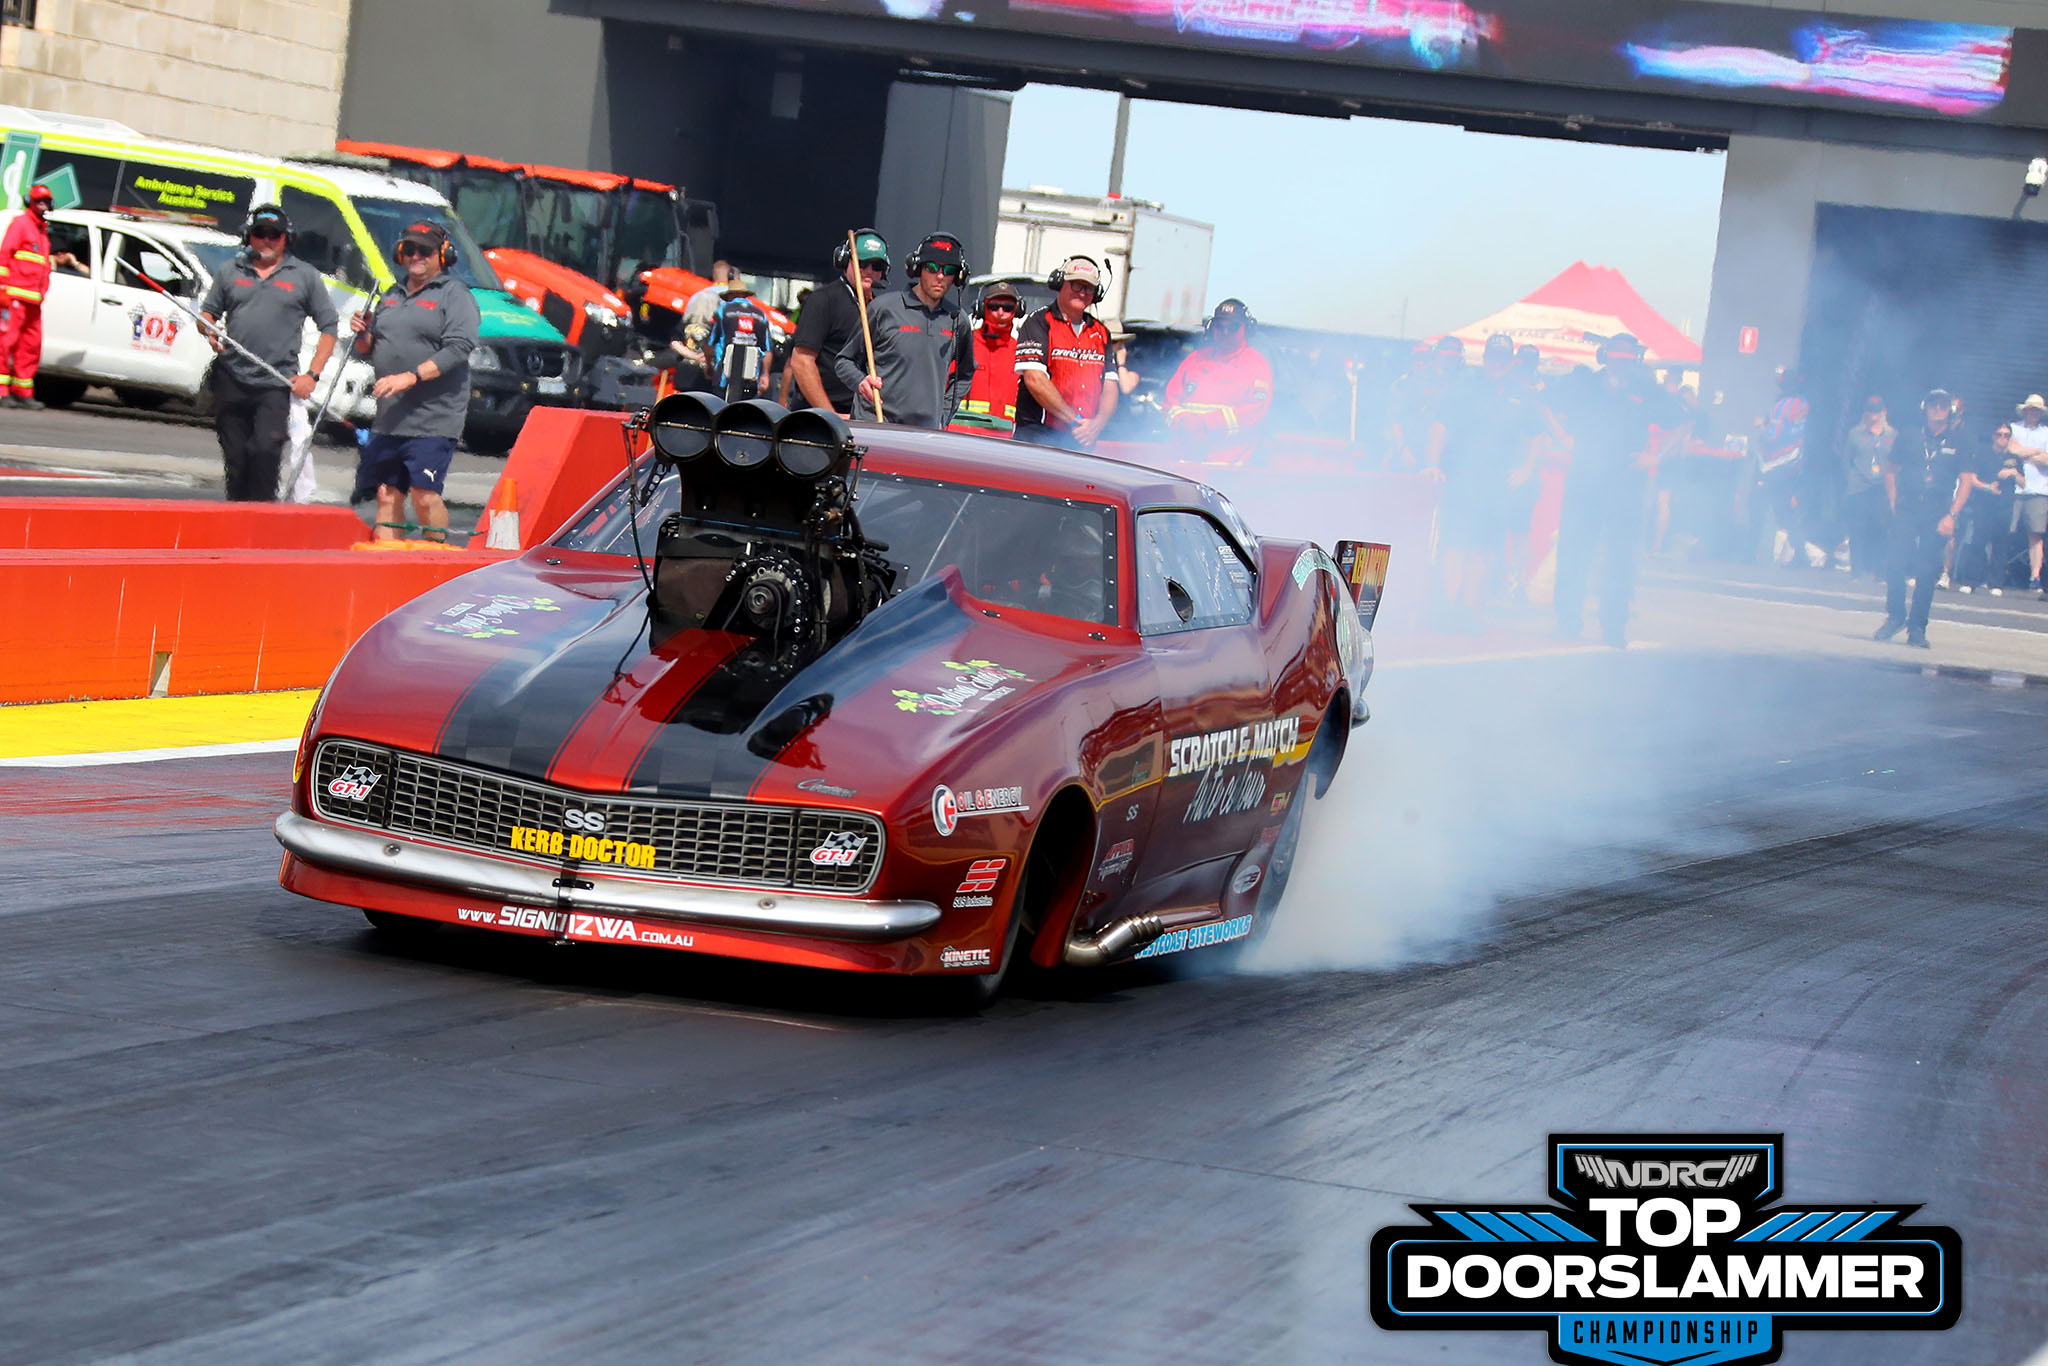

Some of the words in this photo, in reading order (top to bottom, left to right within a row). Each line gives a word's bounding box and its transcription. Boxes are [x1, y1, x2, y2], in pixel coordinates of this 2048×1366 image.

[134, 176, 194, 196] Ambulance
[194, 184, 236, 204] Service
[157, 191, 207, 209] Australia
[1168, 729, 1238, 777] SCRATCH
[1237, 726, 1251, 763] &
[1250, 717, 1300, 760] MATCH
[956, 791, 977, 812] OIL
[984, 786, 1022, 809] ENERGY
[1126, 803, 1139, 821] SS
[564, 808, 605, 832] SS
[510, 825, 565, 856] KERB
[568, 834, 657, 869] DOCTOR
[1187, 914, 1253, 949] SITEWORKS
[943, 949, 991, 962] KINETIC
